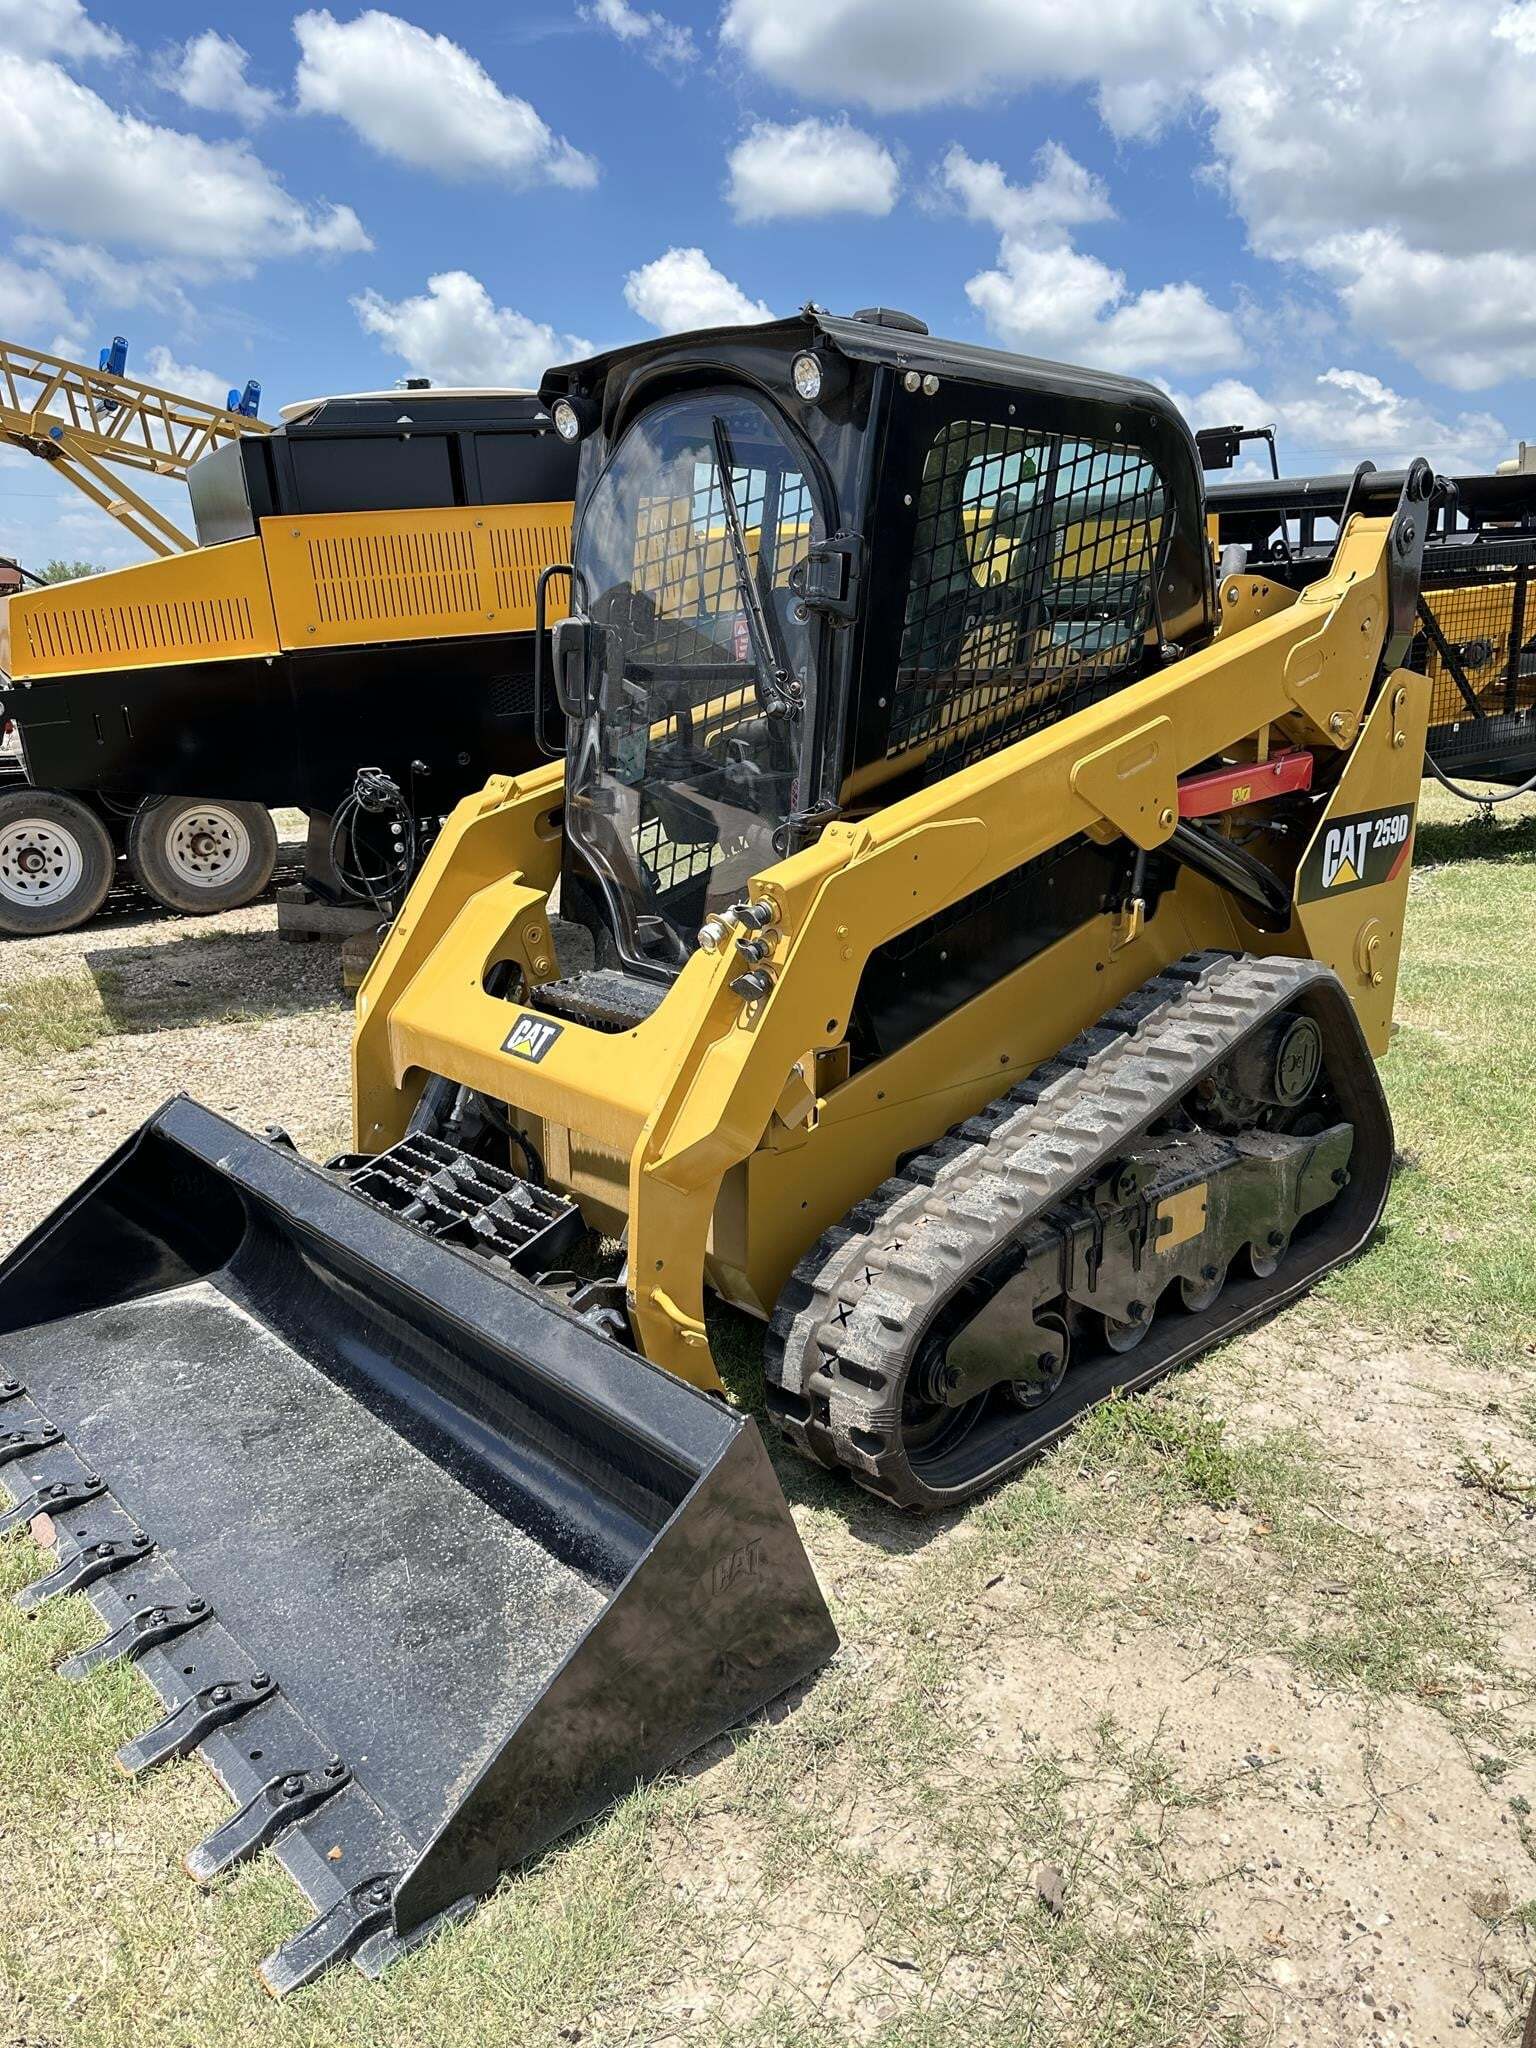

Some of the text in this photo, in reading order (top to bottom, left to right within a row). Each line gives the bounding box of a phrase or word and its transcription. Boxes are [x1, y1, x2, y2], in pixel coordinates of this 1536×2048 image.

[1322, 814, 1409, 888] CAT 259D
[507, 1019, 557, 1058] CAT
[711, 1537, 762, 1597] CAT
